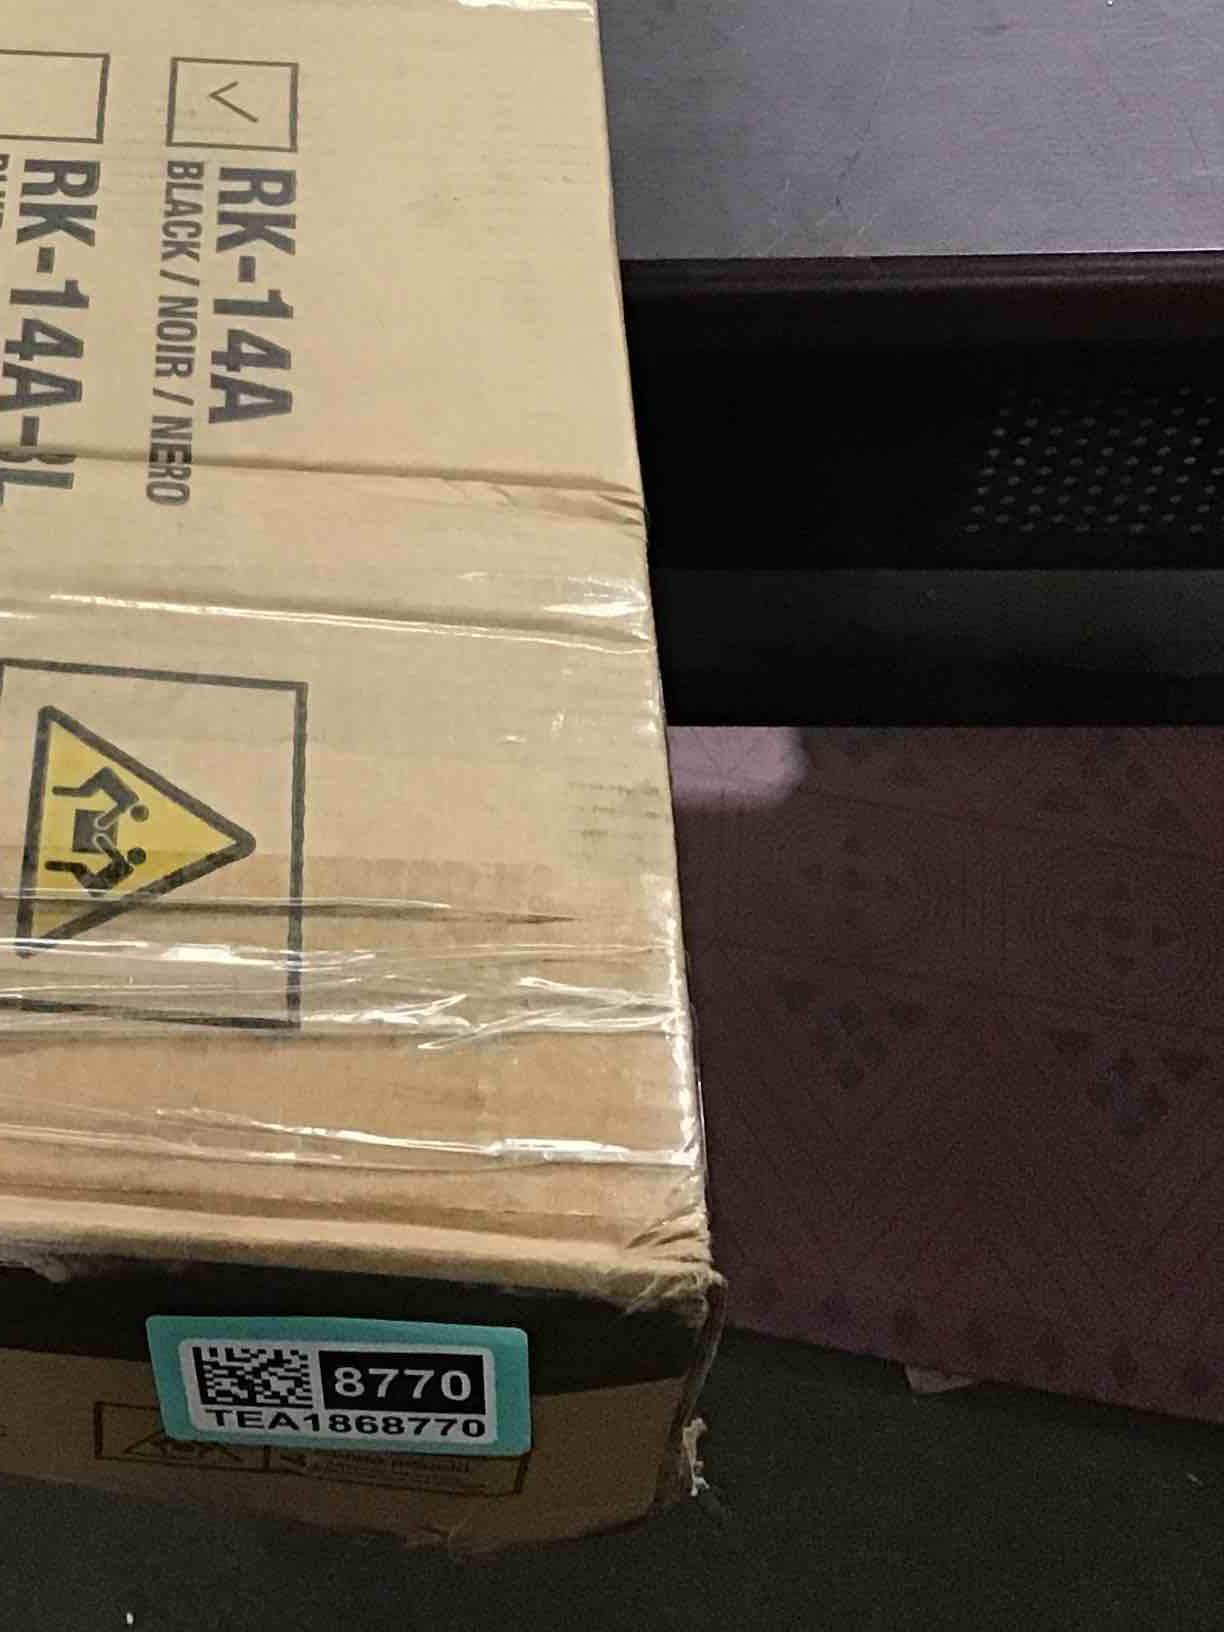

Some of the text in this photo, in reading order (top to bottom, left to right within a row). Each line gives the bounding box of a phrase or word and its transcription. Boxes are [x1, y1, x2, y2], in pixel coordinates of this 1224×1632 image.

[160, 159, 205, 263] BLACK
[154, 295, 199, 380] NOIR
[208, 166, 298, 425] RK-14A
[205, 1407, 486, 1439] TEA1868770
[333, 1365, 473, 1402] 8770
